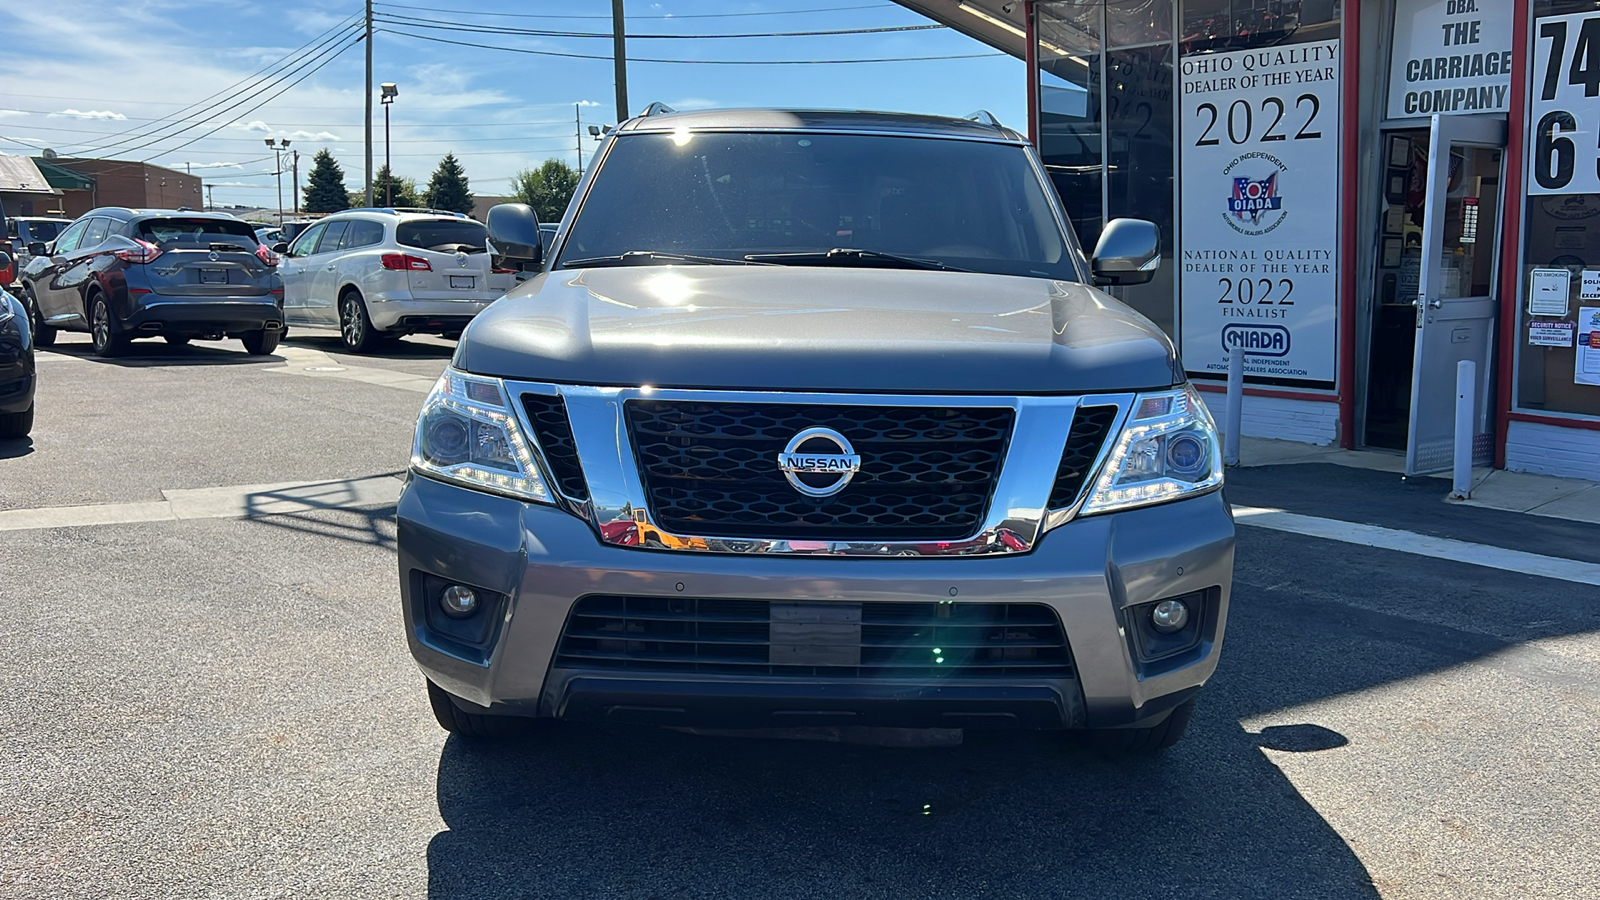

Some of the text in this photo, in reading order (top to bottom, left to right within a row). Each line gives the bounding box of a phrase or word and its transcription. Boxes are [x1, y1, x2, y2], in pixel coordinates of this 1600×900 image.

[1446, 0, 1479, 15] DBA.
[1442, 20, 1481, 46] THE
[1182, 57, 1233, 76] OHIO
[1243, 44, 1338, 72] QUALITY
[1406, 51, 1512, 82] CARRIAGE
[1184, 77, 1236, 94] DEALER
[1240, 75, 1259, 89] OF
[1262, 71, 1291, 86] THE
[1295, 67, 1335, 83] YEAR
[1404, 84, 1508, 114] COMPANY
[1195, 93, 1322, 147] 2022
[1223, 151, 1288, 175] OHIO INDEPENDENT
[1234, 198, 1273, 210] OIADA
[1222, 210, 1288, 237] AUTOMOBILE DEALERS ASSOCIATION
[1184, 250, 1332, 261] NATIONAL QUALITY
[1186, 263, 1330, 274] DEALER OF THE YEAR
[1217, 277, 1295, 305] 2022
[1222, 307, 1288, 319] FINALIST
[1227, 330, 1283, 349] NIADA
[1222, 356, 1290, 366] NAAL INDEPENDENT
[1243, 366, 1266, 374] DEALERS
[1267, 367, 1308, 376] ASSOCIATION
[787, 457, 851, 469] NISSAN
